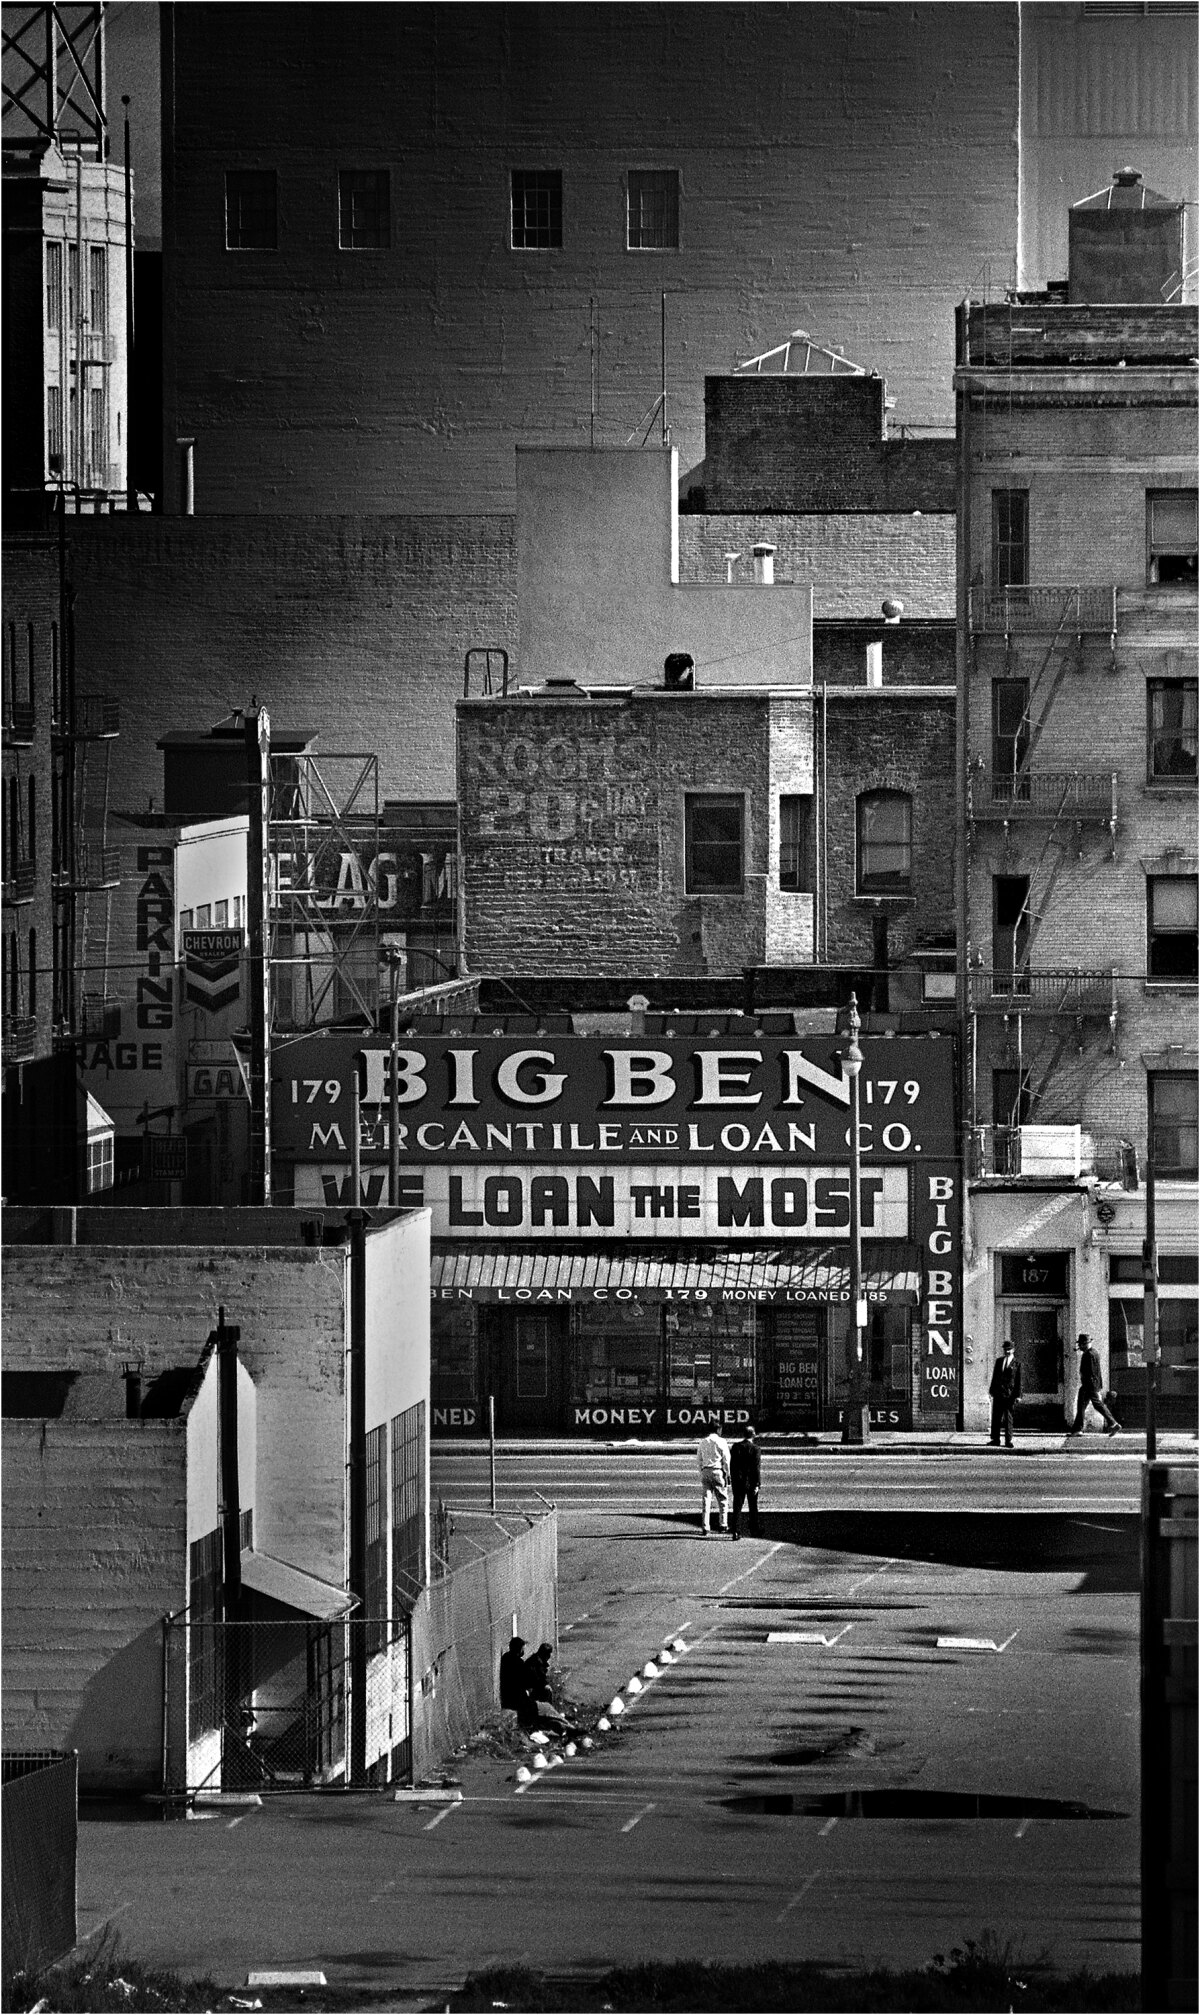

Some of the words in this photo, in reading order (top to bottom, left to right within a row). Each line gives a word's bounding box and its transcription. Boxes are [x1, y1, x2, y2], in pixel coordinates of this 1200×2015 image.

[267, 852, 398, 909] FLAG
[136, 846, 173, 1030] PARKING
[184, 936, 241, 951] CHEVRON
[291, 1080, 341, 1104] 179
[361, 1050, 568, 1104] BIG
[602, 1050, 850, 1105] BEN
[866, 1080, 920, 1105] 179
[309, 1120, 624, 1151] MERCANTILE
[629, 1128, 680, 1145] AND
[688, 1122, 816, 1152] LOAN
[845, 1123, 922, 1152] CO.
[153, 1169, 185, 1177] STAMPS
[449, 1176, 615, 1227] LOAN
[630, 1186, 700, 1218] THE
[717, 1177, 884, 1228] MOST
[928, 1176, 954, 1254] BIG
[1022, 1269, 1050, 1283] 187
[430, 1288, 473, 1299] BEN
[498, 1288, 573, 1300] LOAN
[593, 1288, 639, 1300] CO.
[664, 1289, 709, 1300] 179
[722, 1290, 778, 1301] MONEY
[786, 1291, 851, 1301] LOANED
[862, 1291, 888, 1301] 185
[927, 1270, 953, 1356] BEN
[779, 1362, 798, 1374] BIG
[799, 1362, 818, 1374] BEN
[925, 1366, 956, 1380] LOAN
[779, 1377, 803, 1388] LOAN
[930, 1384, 950, 1398] CO.
[434, 1409, 477, 1426] NED
[575, 1409, 656, 1425] MONEY
[667, 1409, 750, 1425] LOANED
[838, 1410, 899, 1423] LES
